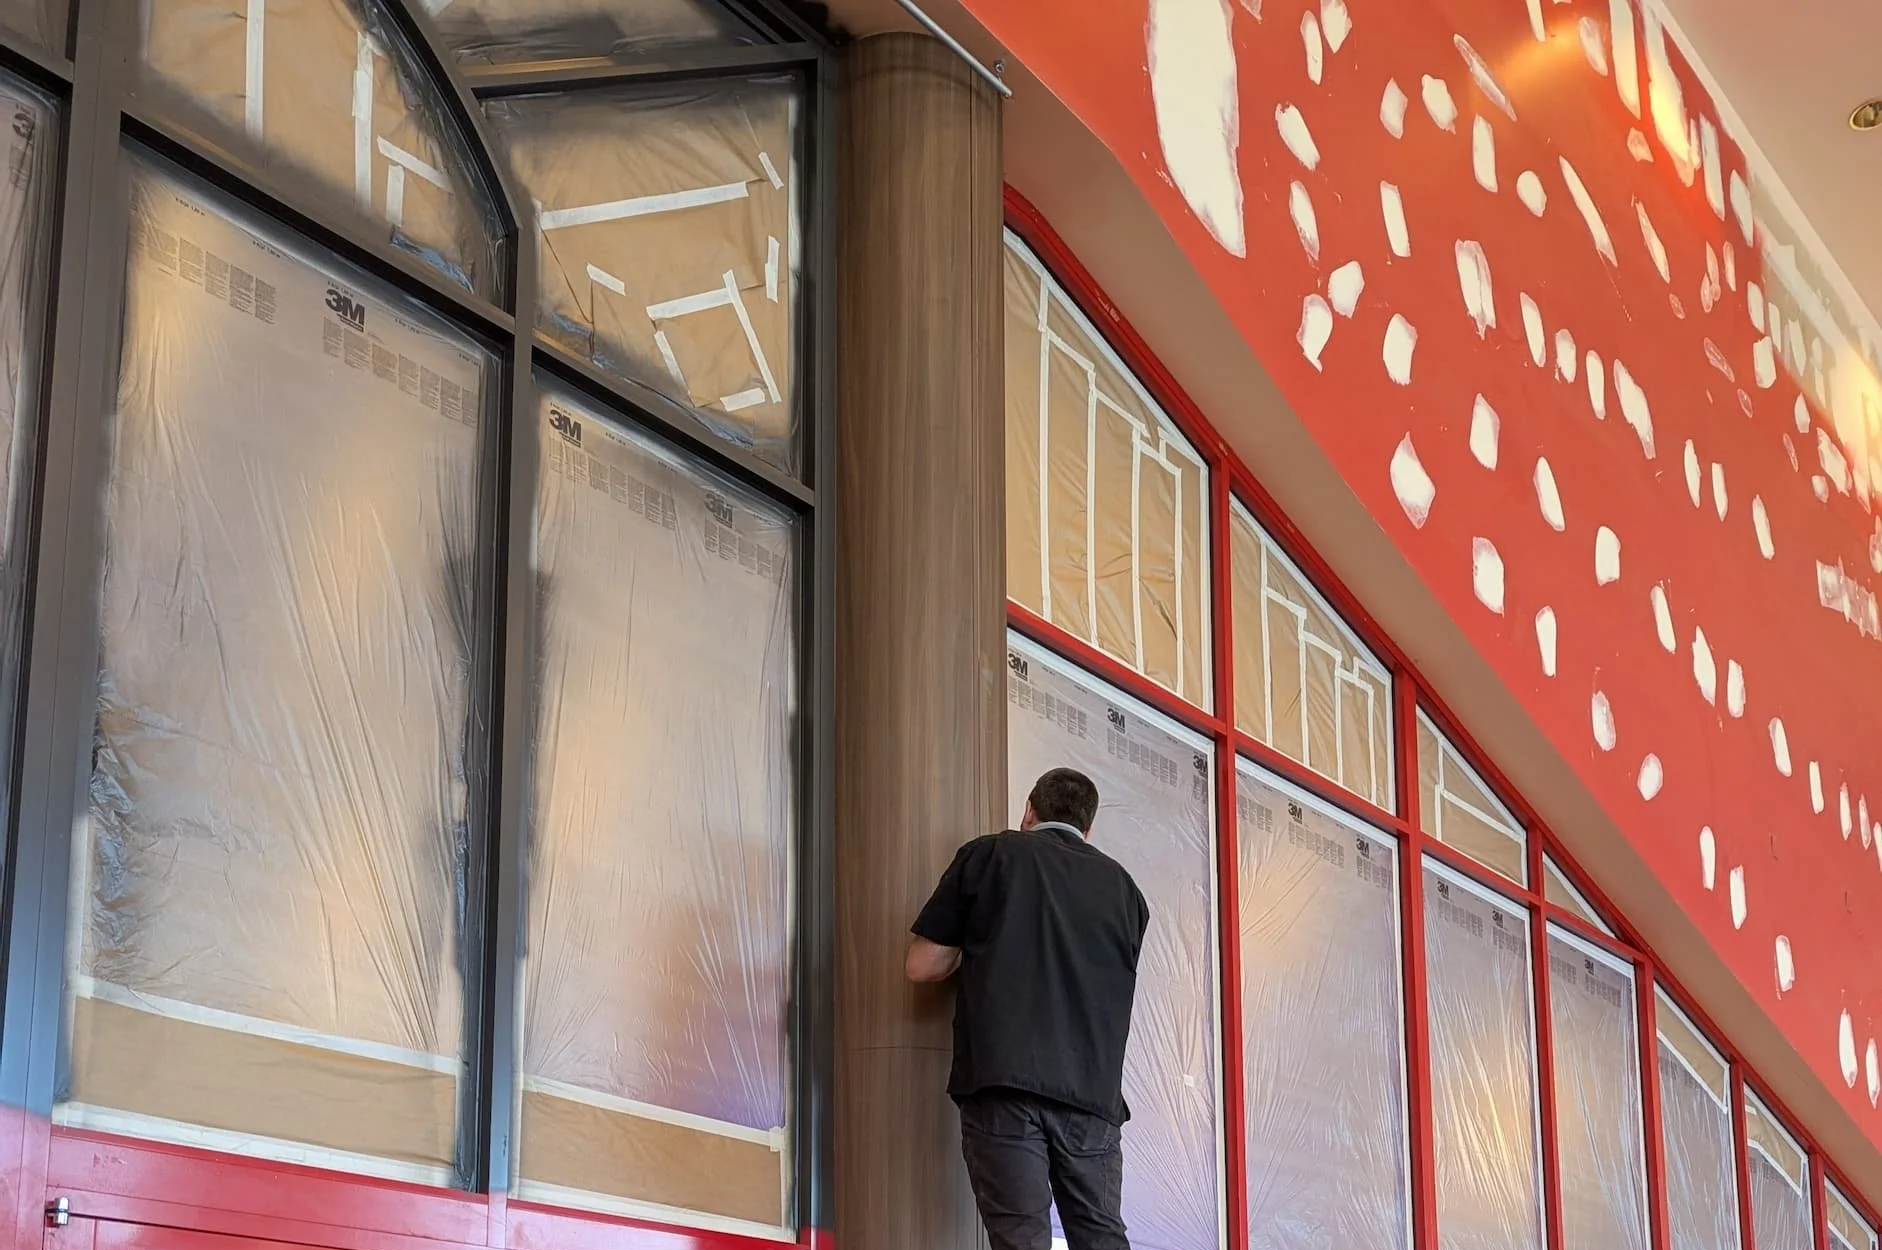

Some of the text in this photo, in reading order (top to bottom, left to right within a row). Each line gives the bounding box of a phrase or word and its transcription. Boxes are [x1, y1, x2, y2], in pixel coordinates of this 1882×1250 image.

[325, 289, 365, 326] 3M
[549, 409, 582, 442] 3M
[704, 493, 734, 523] 3M
[1008, 653, 1029, 676] 3M
[1107, 708, 1126, 729] 3M
[1288, 803, 1303, 821] 3M
[1356, 838, 1370, 856] 3M
[1437, 880, 1449, 896] 3M
[1492, 910, 1504, 926] 3M
